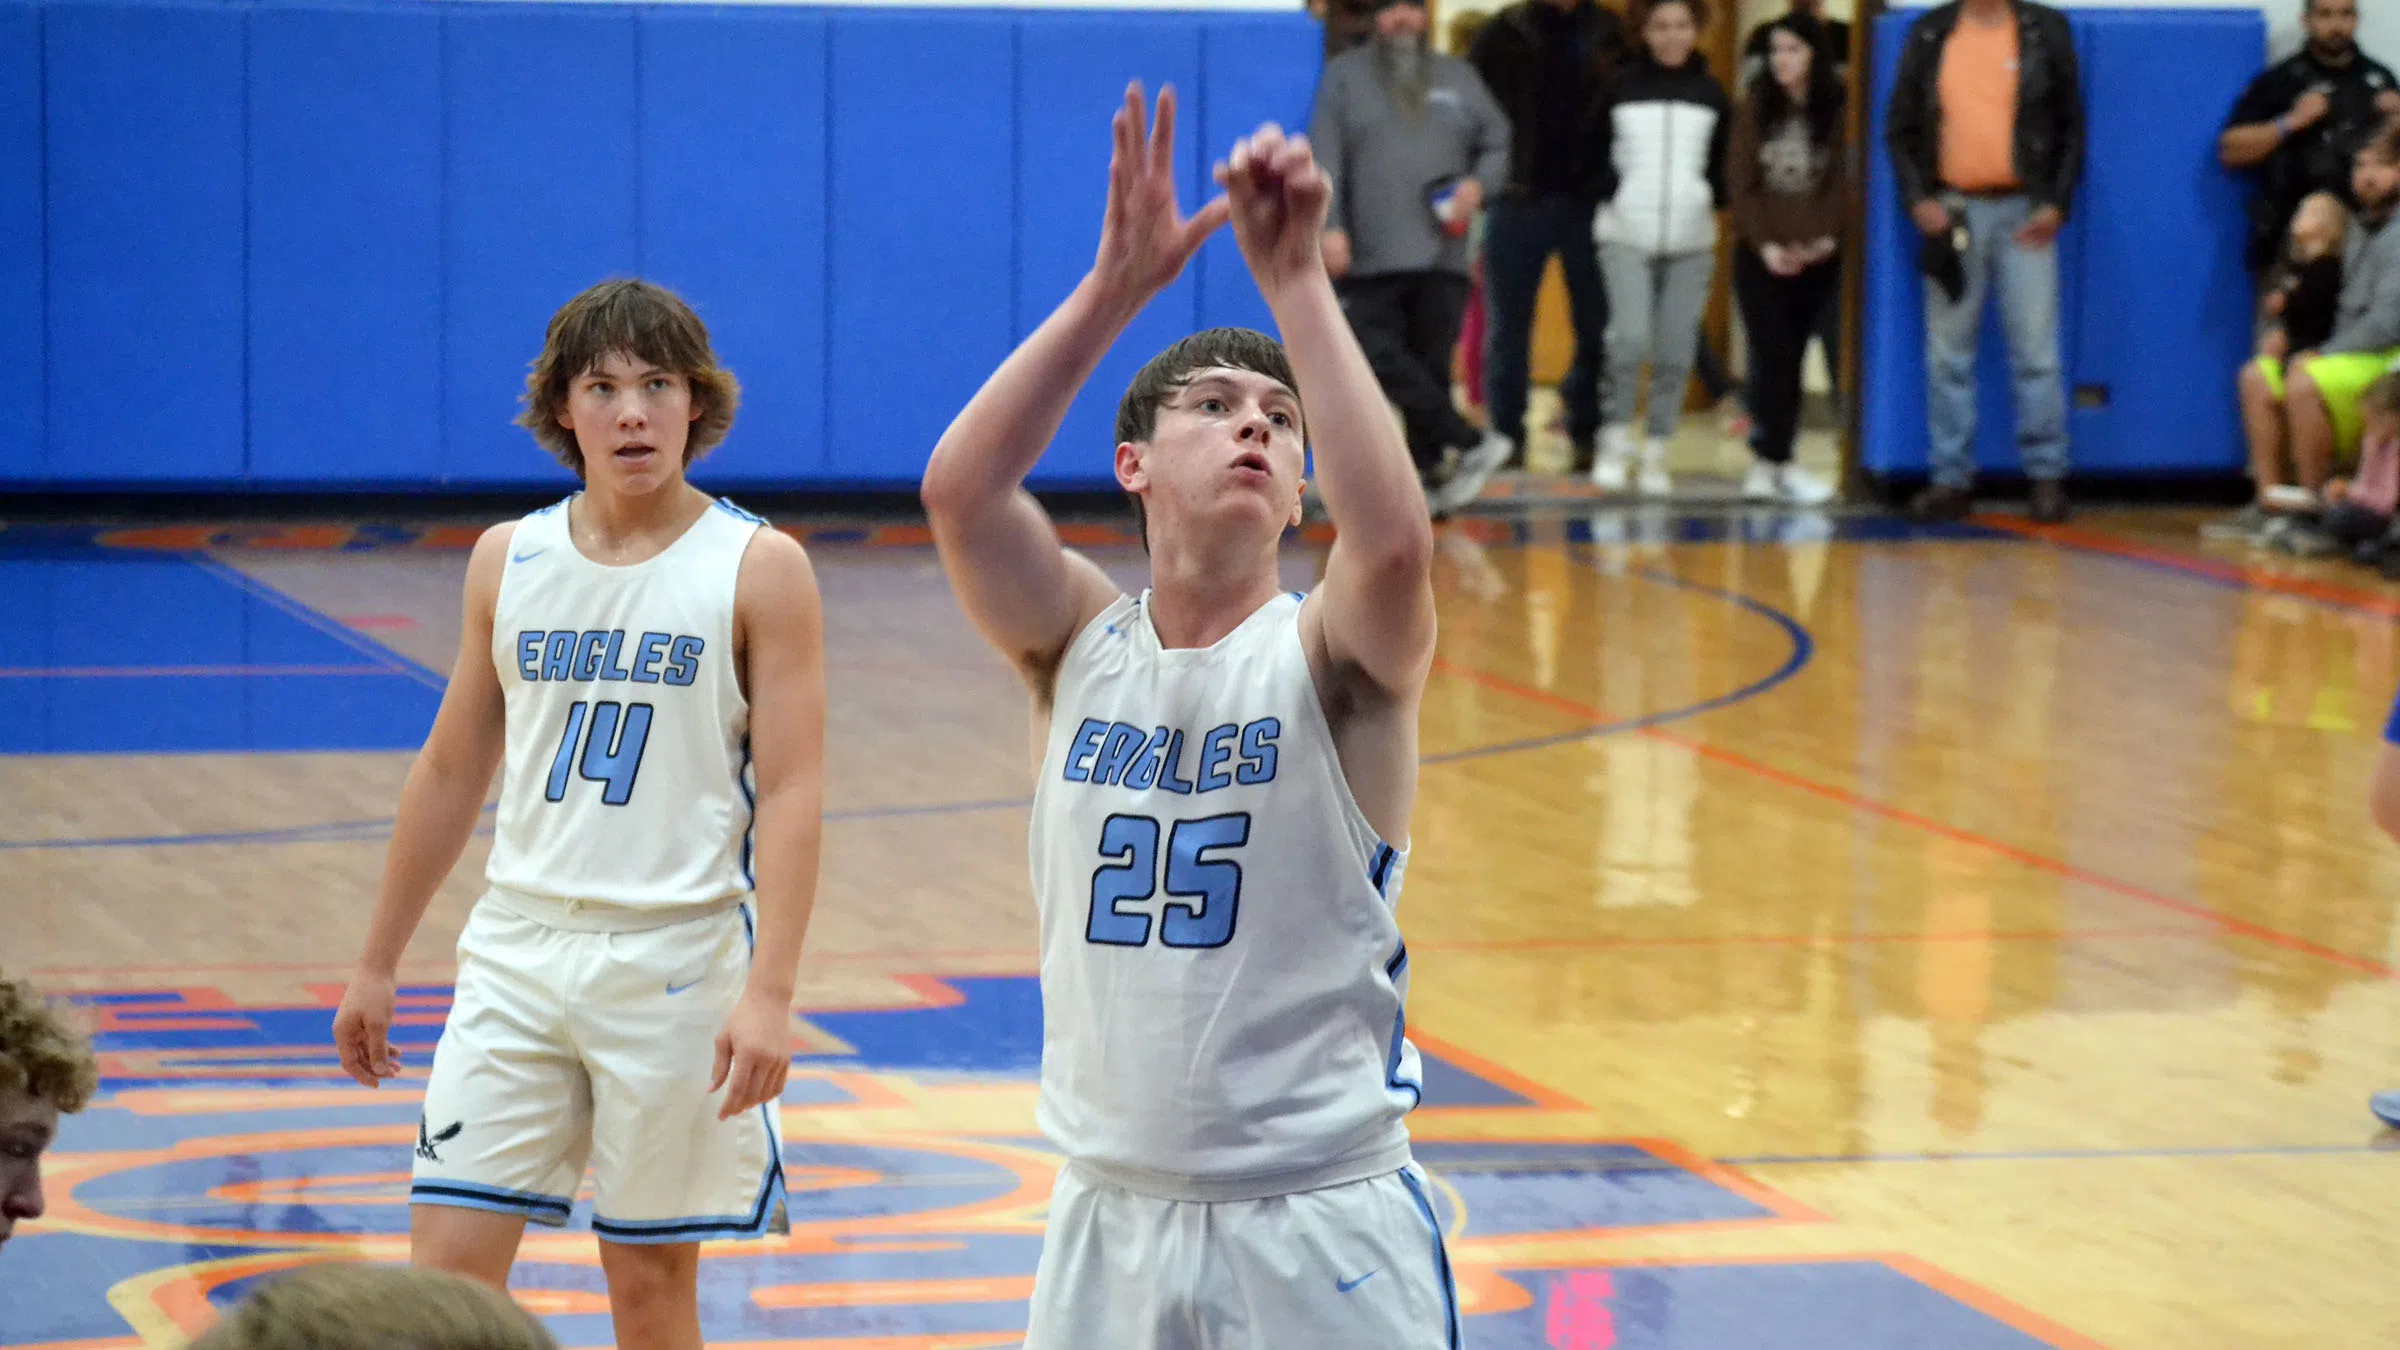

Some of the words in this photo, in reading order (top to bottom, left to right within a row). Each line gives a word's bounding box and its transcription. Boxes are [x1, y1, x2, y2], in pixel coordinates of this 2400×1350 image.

[518, 630, 704, 686] EAGLES
[545, 701, 653, 806] 14
[1063, 717, 1280, 794] EAGLES
[1085, 811, 1251, 949] 25
